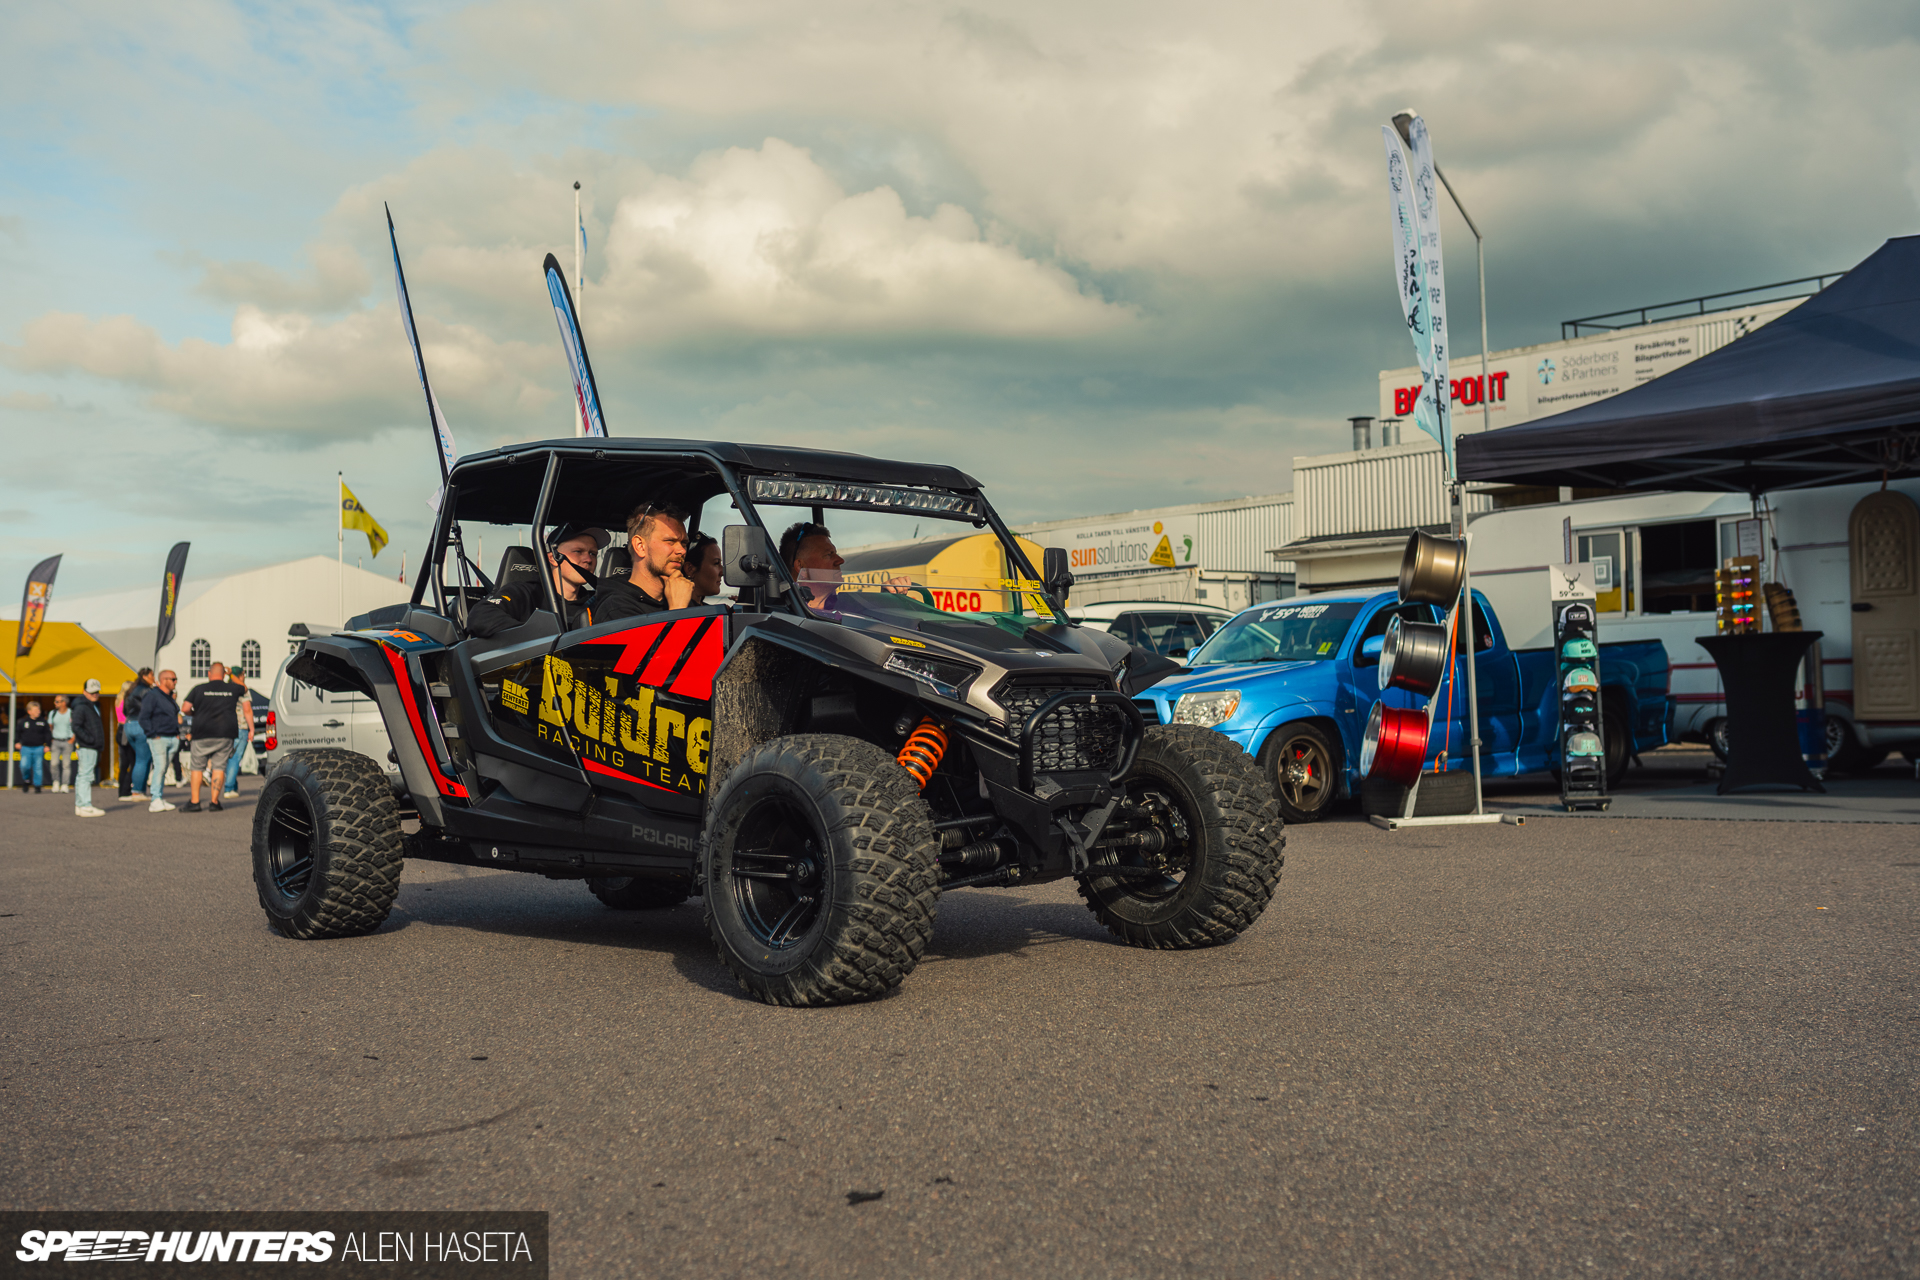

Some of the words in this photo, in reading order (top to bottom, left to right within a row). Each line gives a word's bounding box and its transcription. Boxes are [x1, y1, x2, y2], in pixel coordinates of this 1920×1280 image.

[1561, 351, 1620, 369] Söderberg
[1561, 370, 1570, 382] &
[1572, 365, 1619, 381] Partners
[1394, 371, 1510, 416] BIPORT
[1076, 532, 1094, 540] KOLLA
[1094, 530, 1112, 538] TAKEN
[1113, 528, 1124, 536] TILL
[1125, 526, 1151, 535] VÄNSTER
[998, 578, 1041, 589] POLARIS
[932, 591, 981, 613] TACO
[503, 679, 530, 700] EIK
[281, 735, 347, 746] mollerssverige.se
[538, 723, 625, 768] RACING
